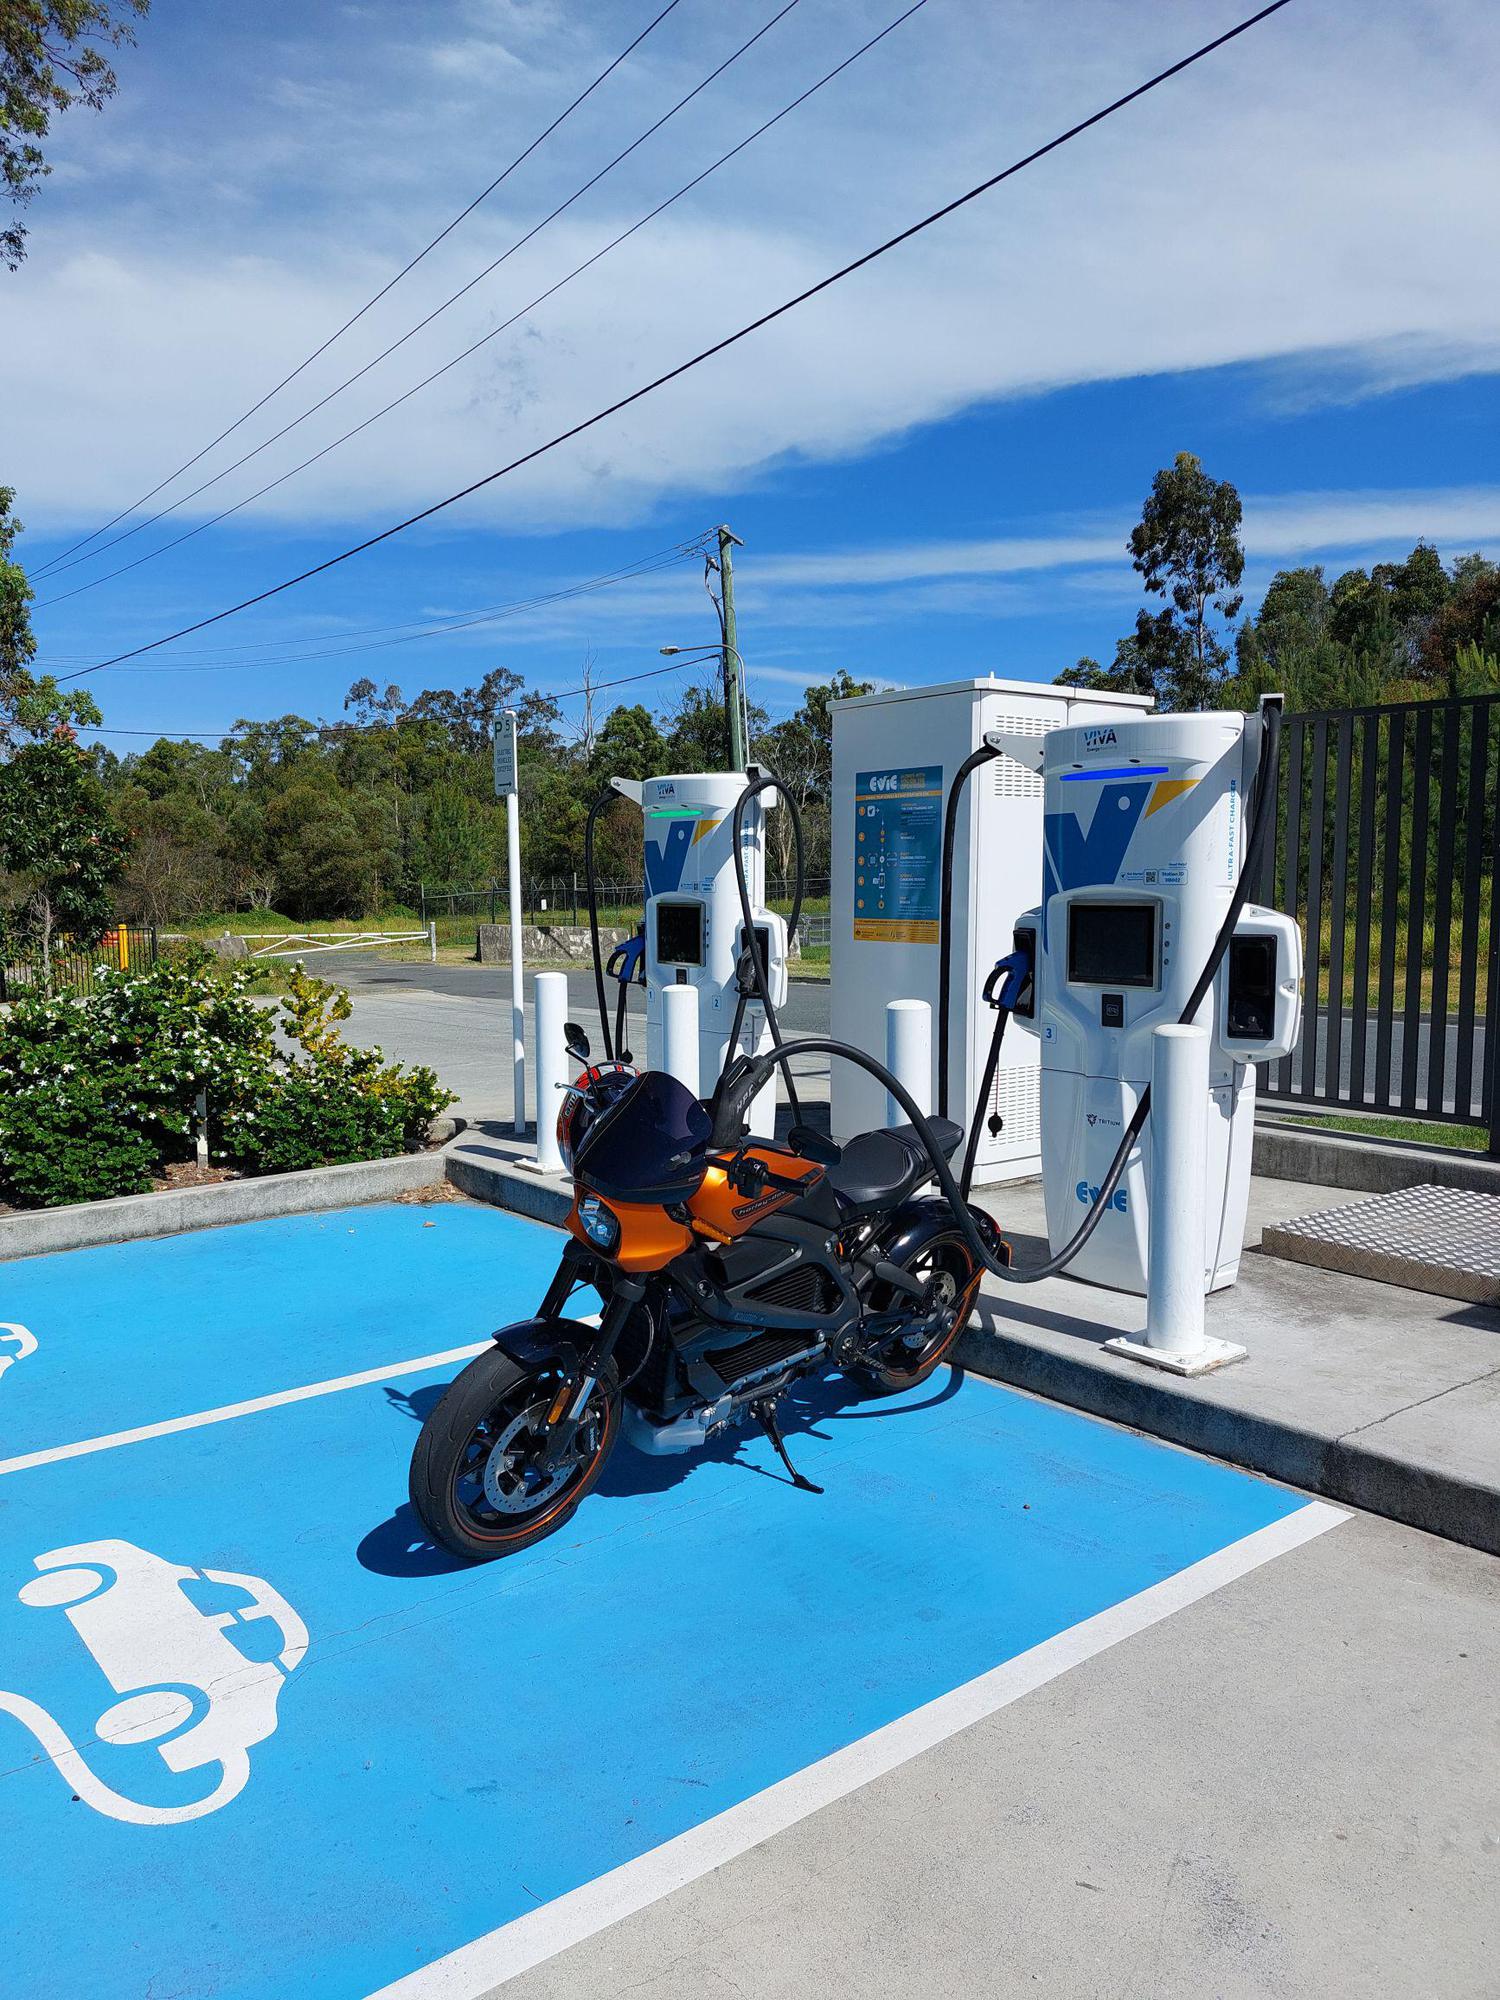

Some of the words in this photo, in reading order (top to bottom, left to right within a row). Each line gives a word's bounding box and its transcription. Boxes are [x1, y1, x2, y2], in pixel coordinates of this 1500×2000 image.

[494, 721, 503, 740] P
[505, 720, 511, 731] 5
[1083, 728, 1118, 747] VIVA
[656, 783, 676, 795] VIVA
[1229, 779, 1237, 823] CHARGER
[1227, 825, 1236, 881] ULTRA-FAST
[714, 999, 719, 1008] 2
[1045, 1027, 1053, 1039] 3
[736, 1084, 754, 1114] HPC
[1098, 1118, 1121, 1126] TRITIUM
